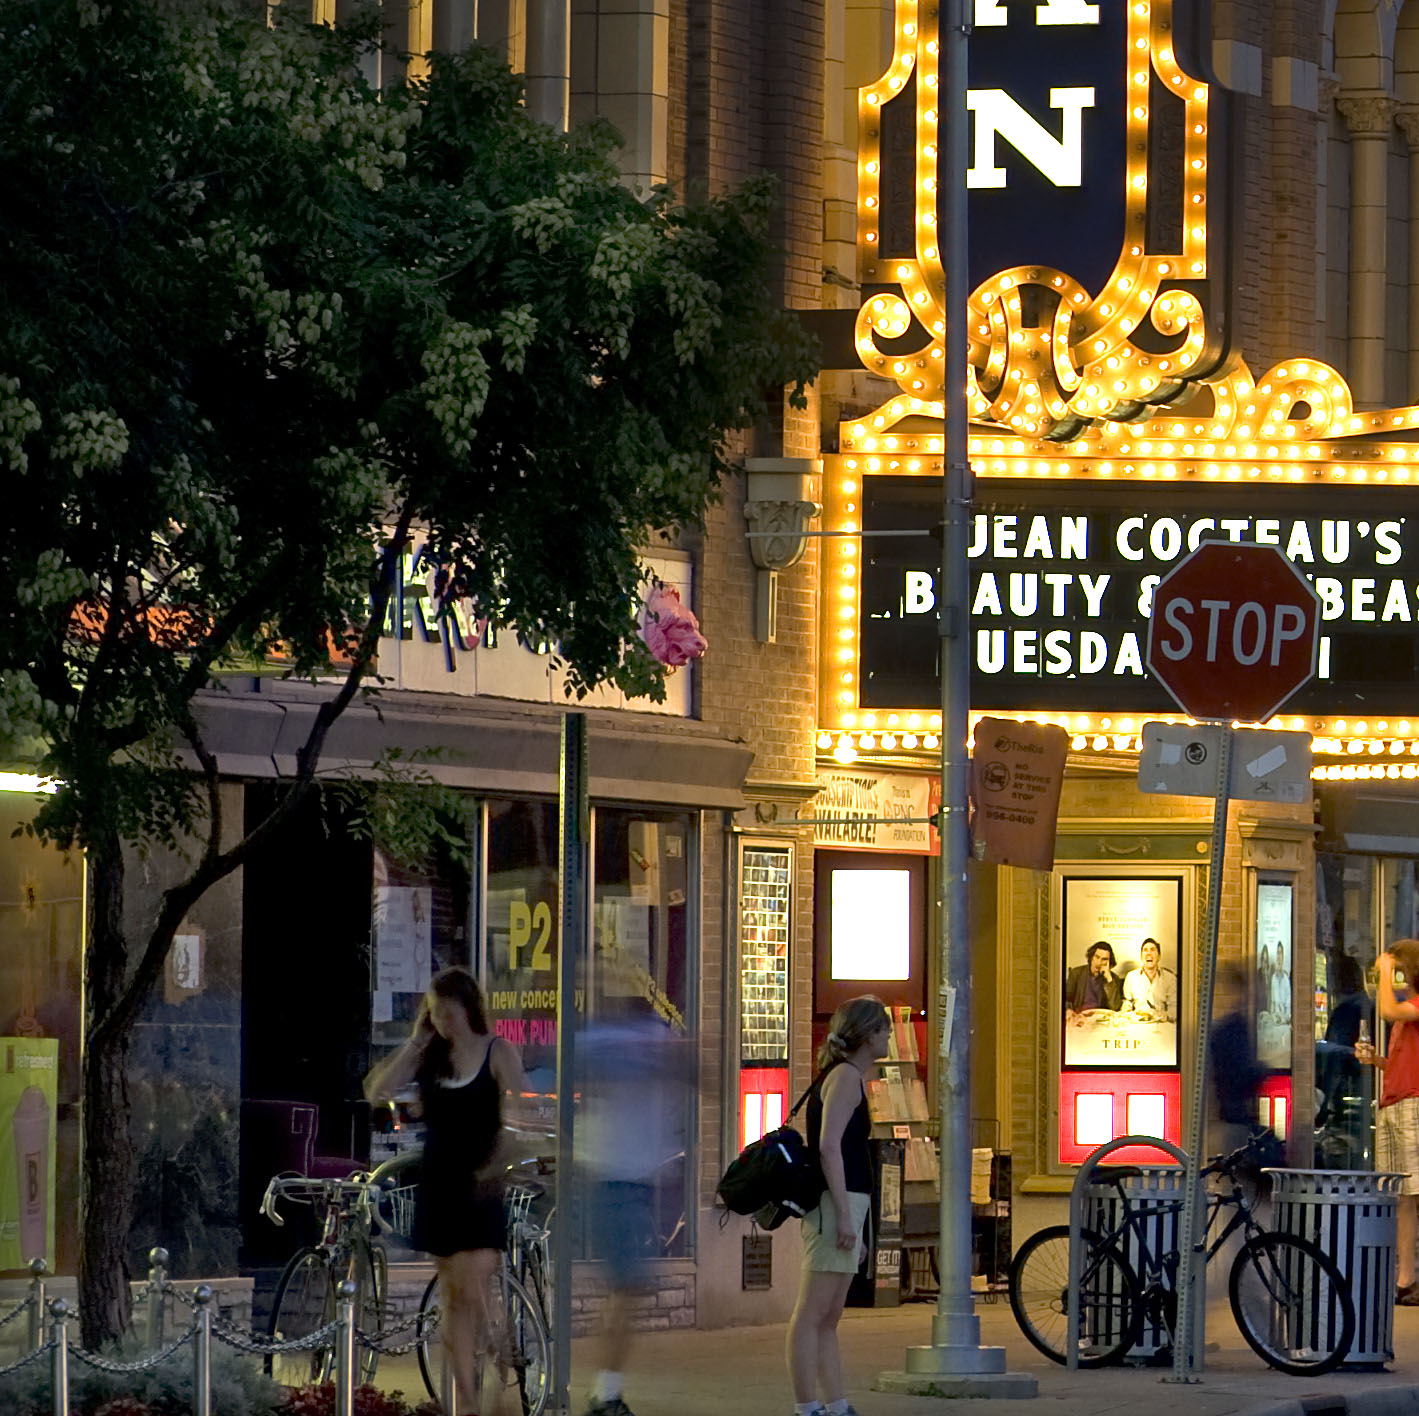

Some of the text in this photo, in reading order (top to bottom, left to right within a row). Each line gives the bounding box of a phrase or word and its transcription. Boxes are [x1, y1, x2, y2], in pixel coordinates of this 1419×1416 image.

[967, 514, 1088, 560] JEAN
[905, 570, 1111, 617] BAUTY
[1160, 597, 1306, 667] STOP
[509, 901, 552, 971] P2
[492, 990, 518, 1011] new
[1102, 1039, 1141, 1049] TRIP
